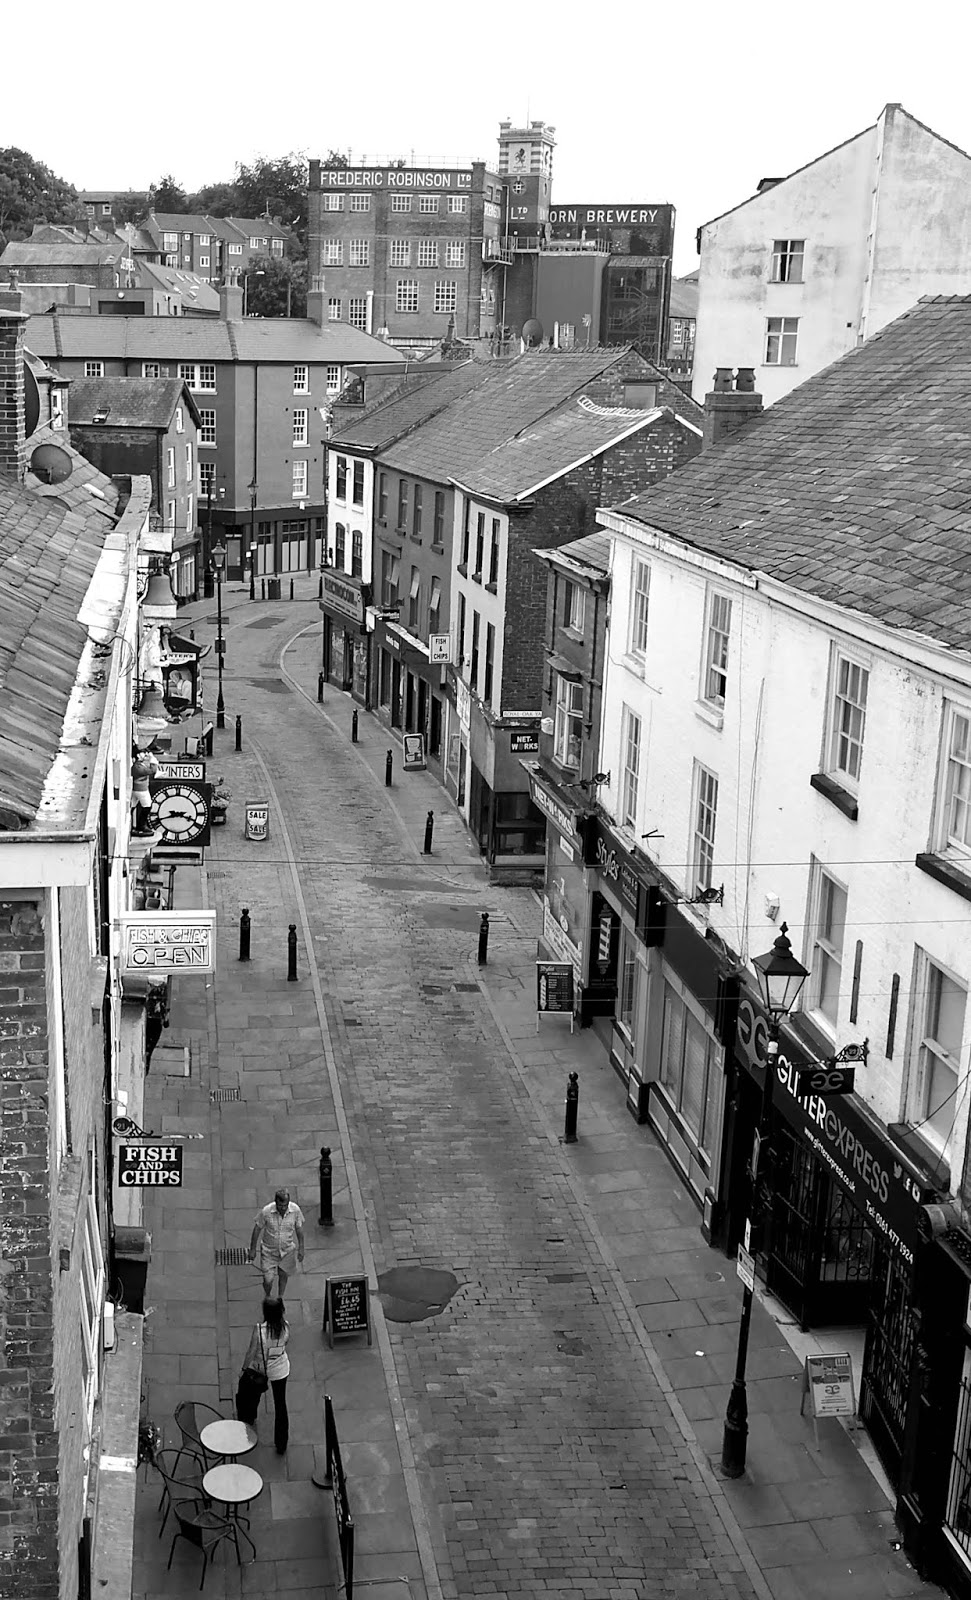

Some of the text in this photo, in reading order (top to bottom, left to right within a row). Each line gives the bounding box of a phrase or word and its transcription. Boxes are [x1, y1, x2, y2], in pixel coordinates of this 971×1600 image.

[320, 171, 383, 186] FREDERIC
[387, 172, 450, 187] ROBINSON
[586, 209, 658, 223] BREWERY
[249, 811, 266, 819] SALE
[249, 824, 267, 833] SALE
[130, 929, 155, 944] FISH
[171, 928, 208, 943] CHIPS
[131, 948, 205, 966] OPEN
[125, 1147, 178, 1162] FISH
[137, 1161, 164, 1171] AND
[121, 1170, 180, 1185] CHIPS
[875, 1212, 889, 1235] 0161
[888, 1228, 900, 1247] 477
[899, 1241, 914, 1265] 1924
